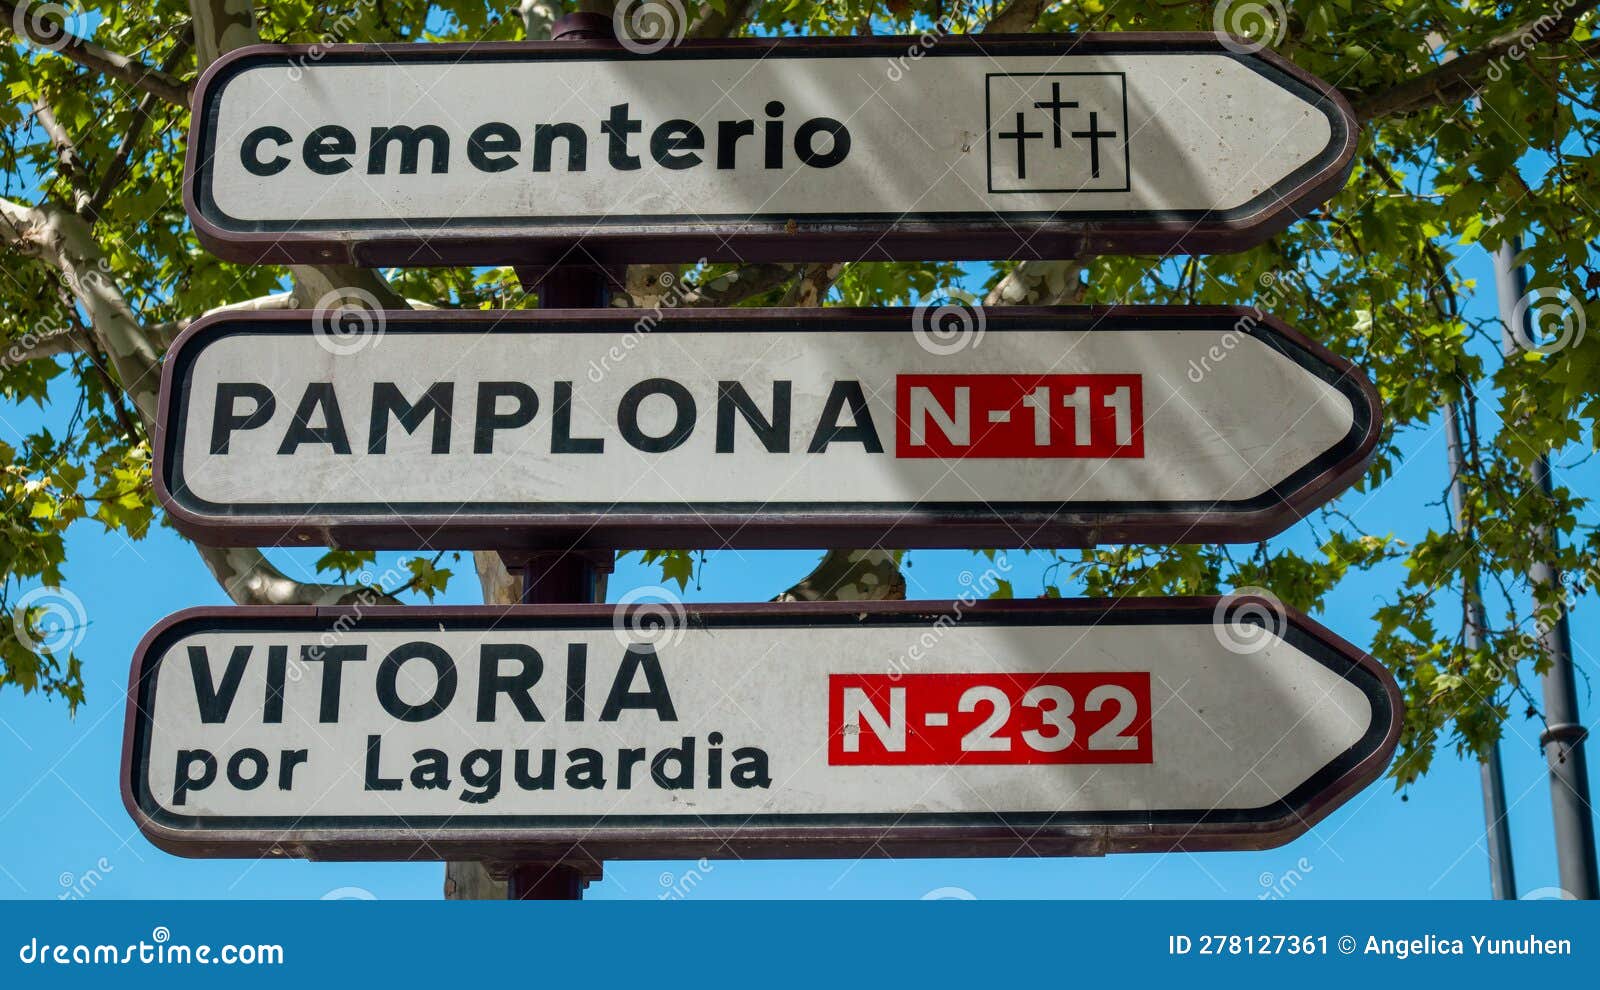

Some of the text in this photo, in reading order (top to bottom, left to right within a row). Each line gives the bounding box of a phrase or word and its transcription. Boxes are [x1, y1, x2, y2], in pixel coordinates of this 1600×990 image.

[240, 100, 852, 177] cementerio
[209, 377, 1133, 455] PAMPLONA N-111
[187, 641, 678, 724] VITORIA
[842, 684, 1139, 753] N-232
[172, 731, 773, 806] por Laguardia
